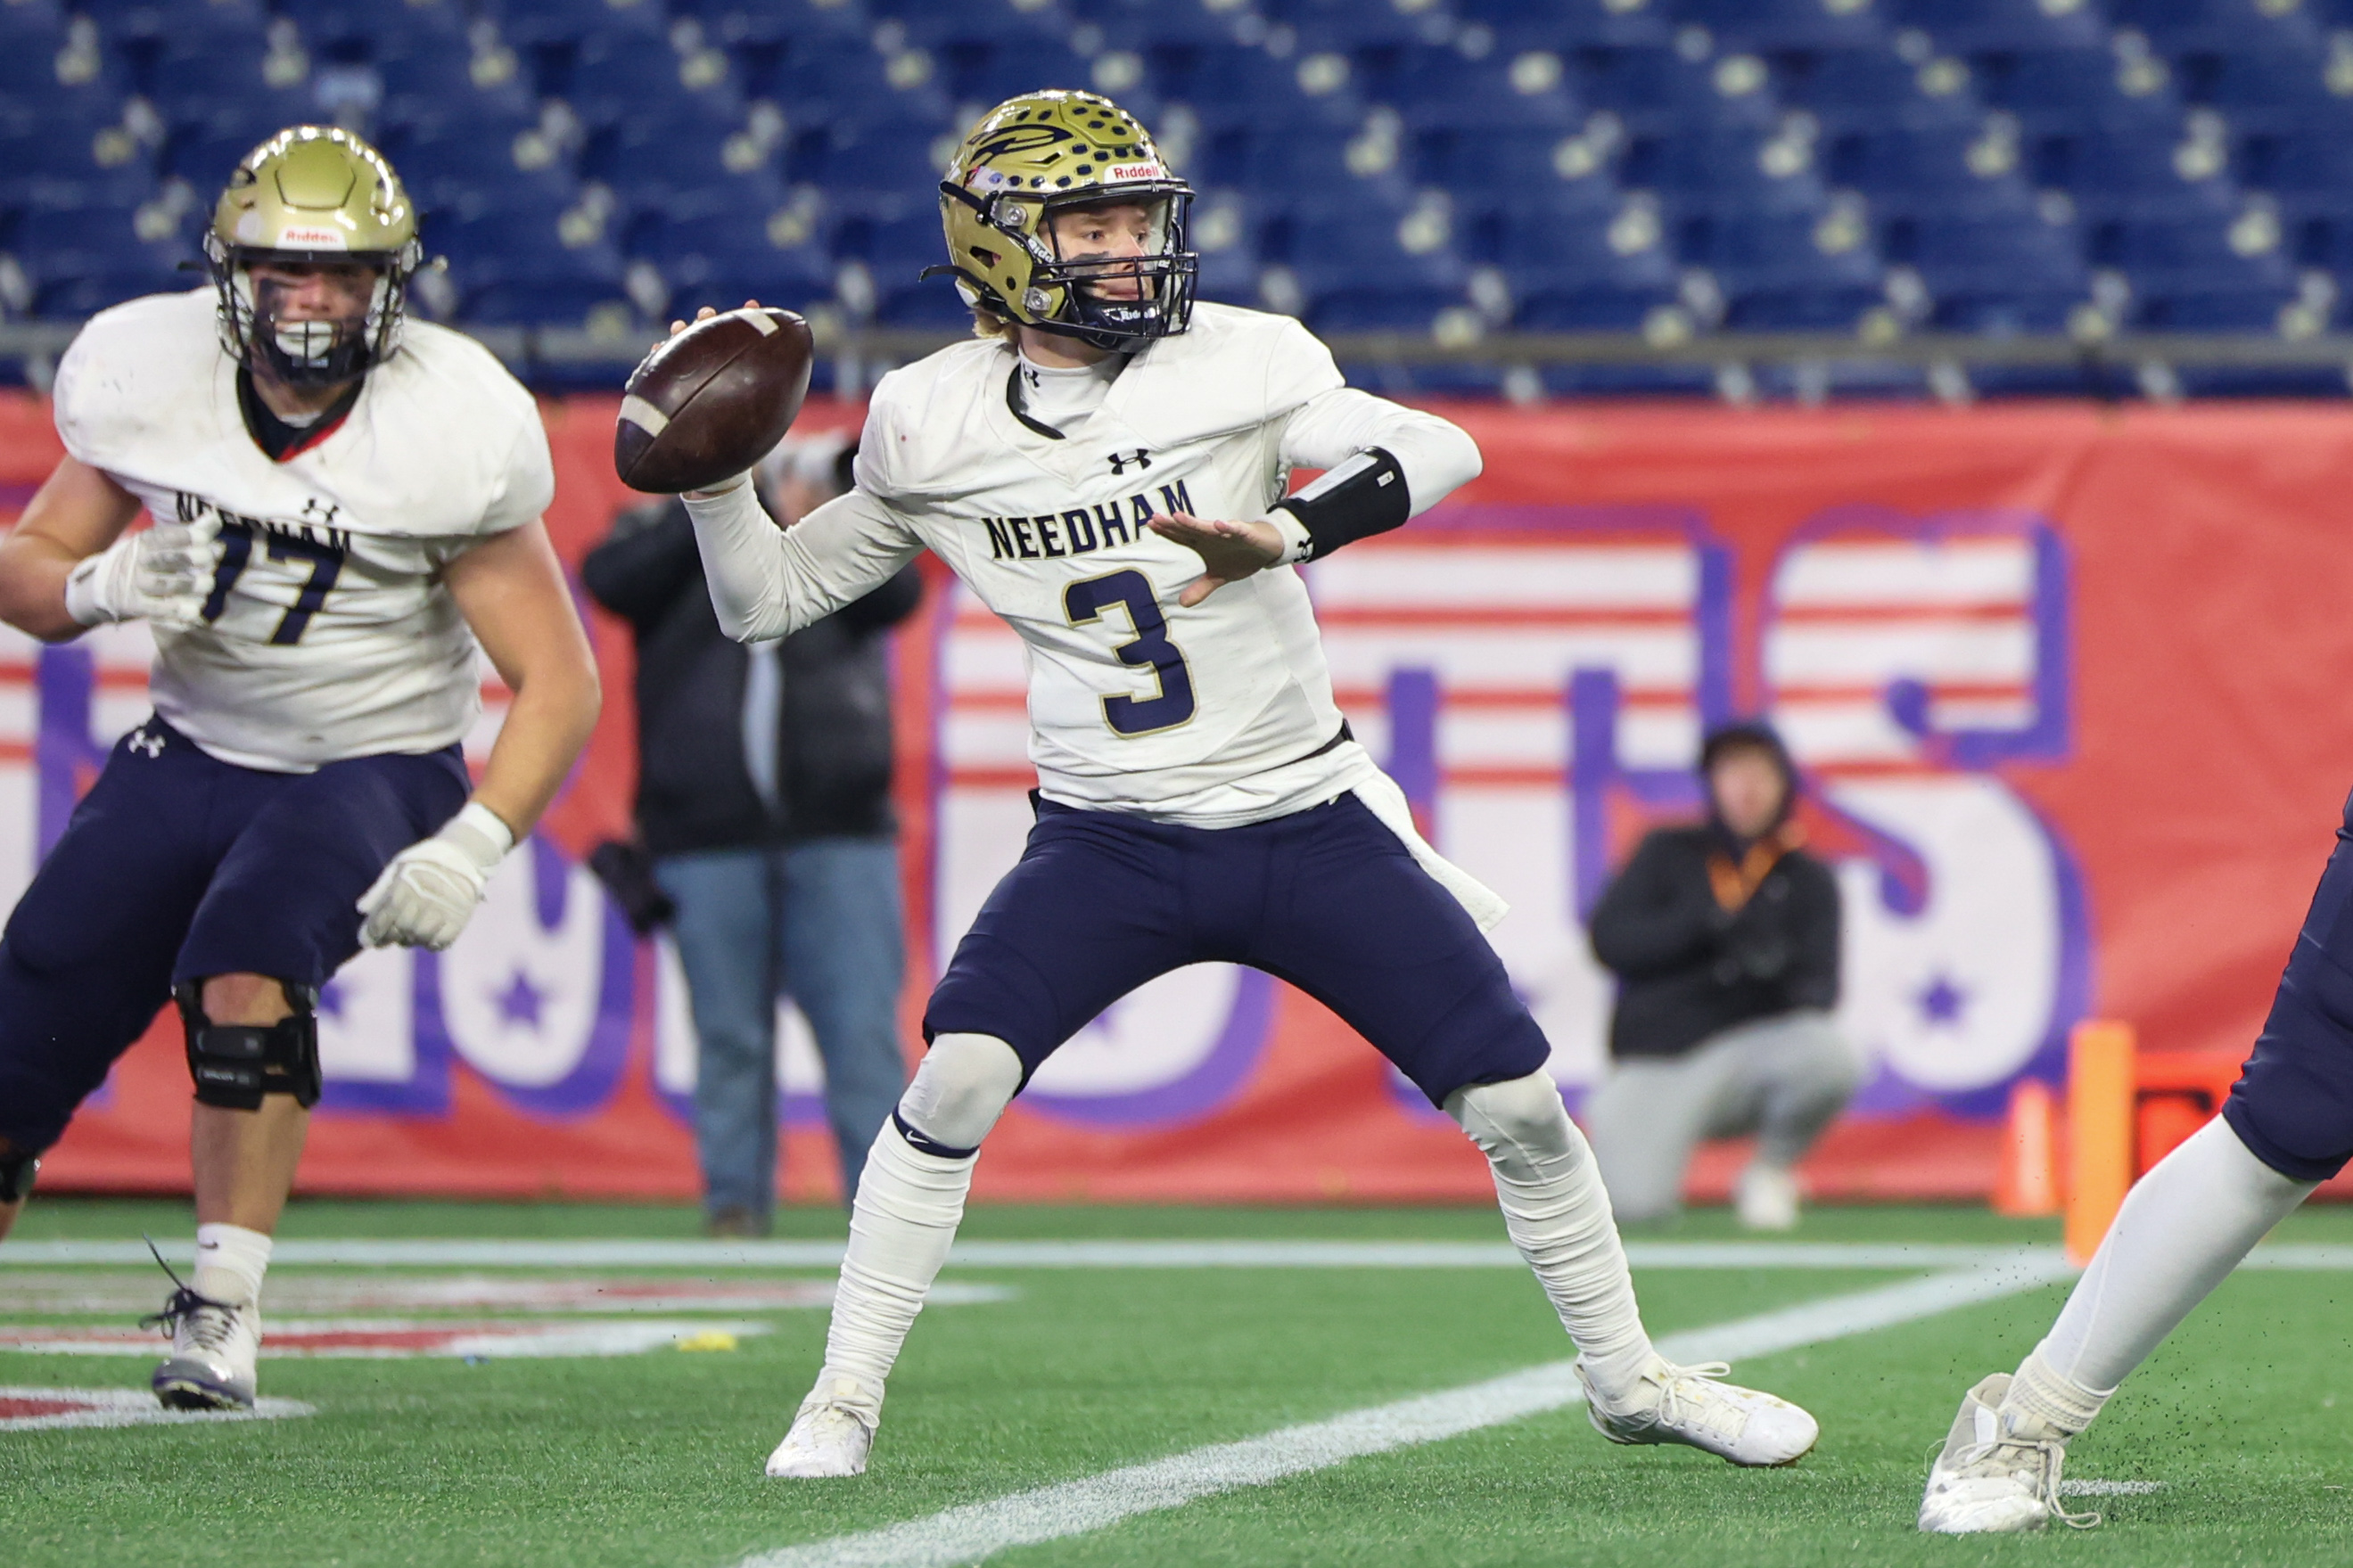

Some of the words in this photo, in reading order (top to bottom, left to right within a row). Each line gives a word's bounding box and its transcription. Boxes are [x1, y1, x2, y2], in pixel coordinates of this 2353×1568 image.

[1114, 166, 1159, 179] Riddell
[981, 479, 1196, 561] NEEDHAM
[201, 521, 345, 647] 77
[1061, 566, 1199, 739] 3
